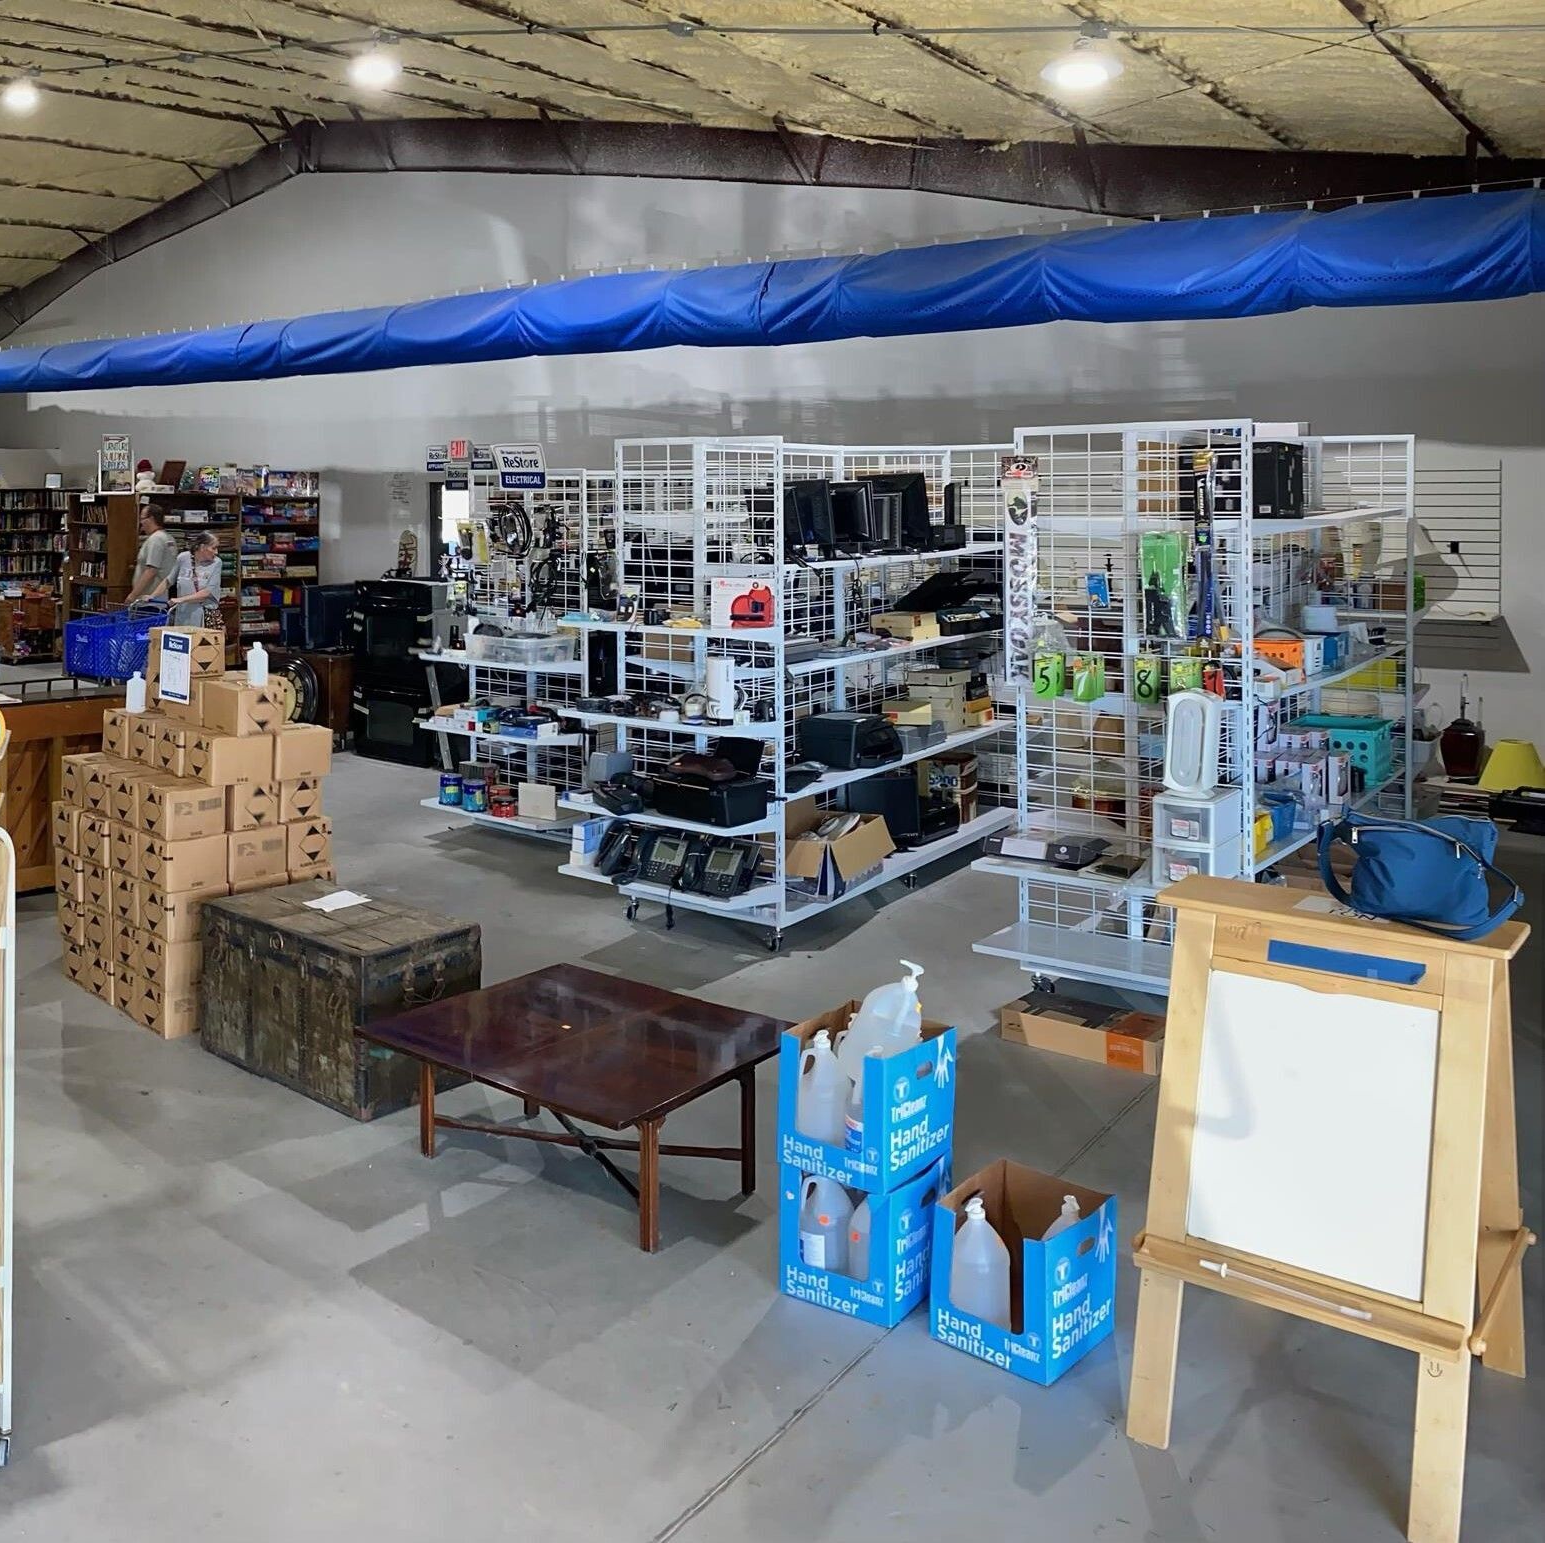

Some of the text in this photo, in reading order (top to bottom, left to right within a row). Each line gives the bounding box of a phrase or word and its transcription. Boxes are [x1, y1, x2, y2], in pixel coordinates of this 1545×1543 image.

[451, 441, 466, 457] EXIT
[503, 456, 539, 468] ReStore
[505, 475, 542, 485] ELECTRICAL
[1009, 532, 1028, 626] MOSSY
[1037, 666, 1050, 694] 5
[1137, 669, 1153, 699] 8
[783, 1134, 824, 1161] Hand
[890, 1114, 929, 1150] Hand
[890, 1123, 950, 1172] Sanitizer
[783, 1149, 853, 1184] Sanitizer
[787, 1265, 829, 1291] Hand
[895, 1240, 930, 1283] Hand
[787, 1280, 859, 1316] Sanitizer
[1053, 1293, 1091, 1338] Hand
[938, 1308, 982, 1339] Hand
[1052, 1298, 1111, 1359] Sanitizer
[937, 1325, 1012, 1369] Sanitizer
